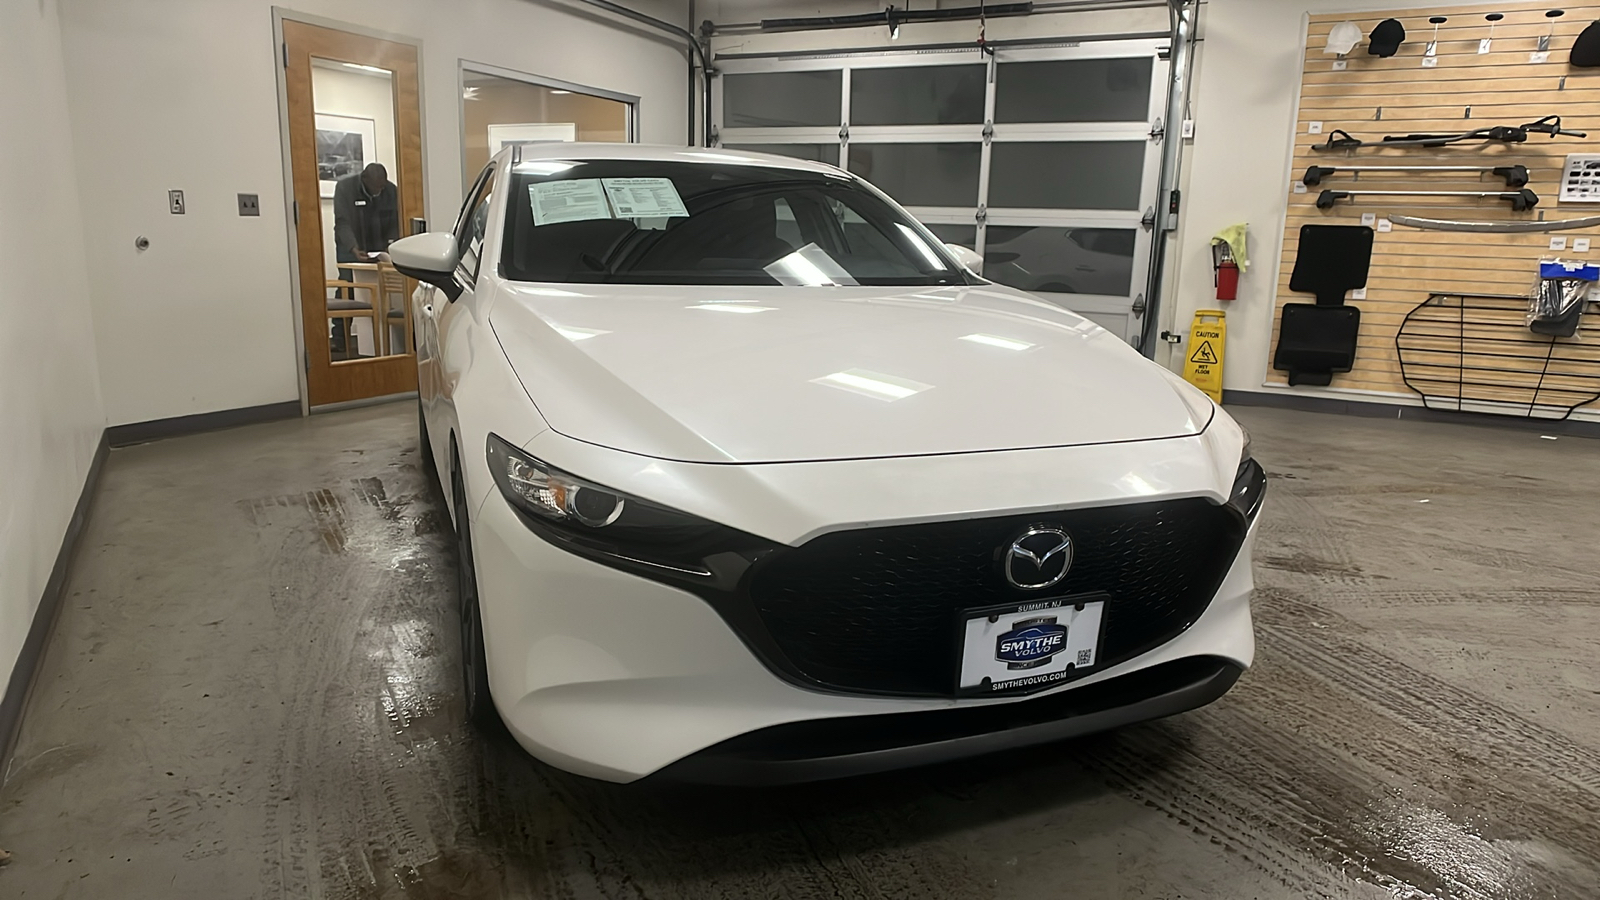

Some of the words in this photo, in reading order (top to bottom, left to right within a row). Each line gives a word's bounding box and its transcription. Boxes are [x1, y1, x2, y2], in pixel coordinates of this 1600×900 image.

[1000, 635, 1062, 653] SMYTHE
[1014, 646, 1051, 657] VOLVO
[992, 672, 1067, 690] SMYTHEVOLVO.COM
